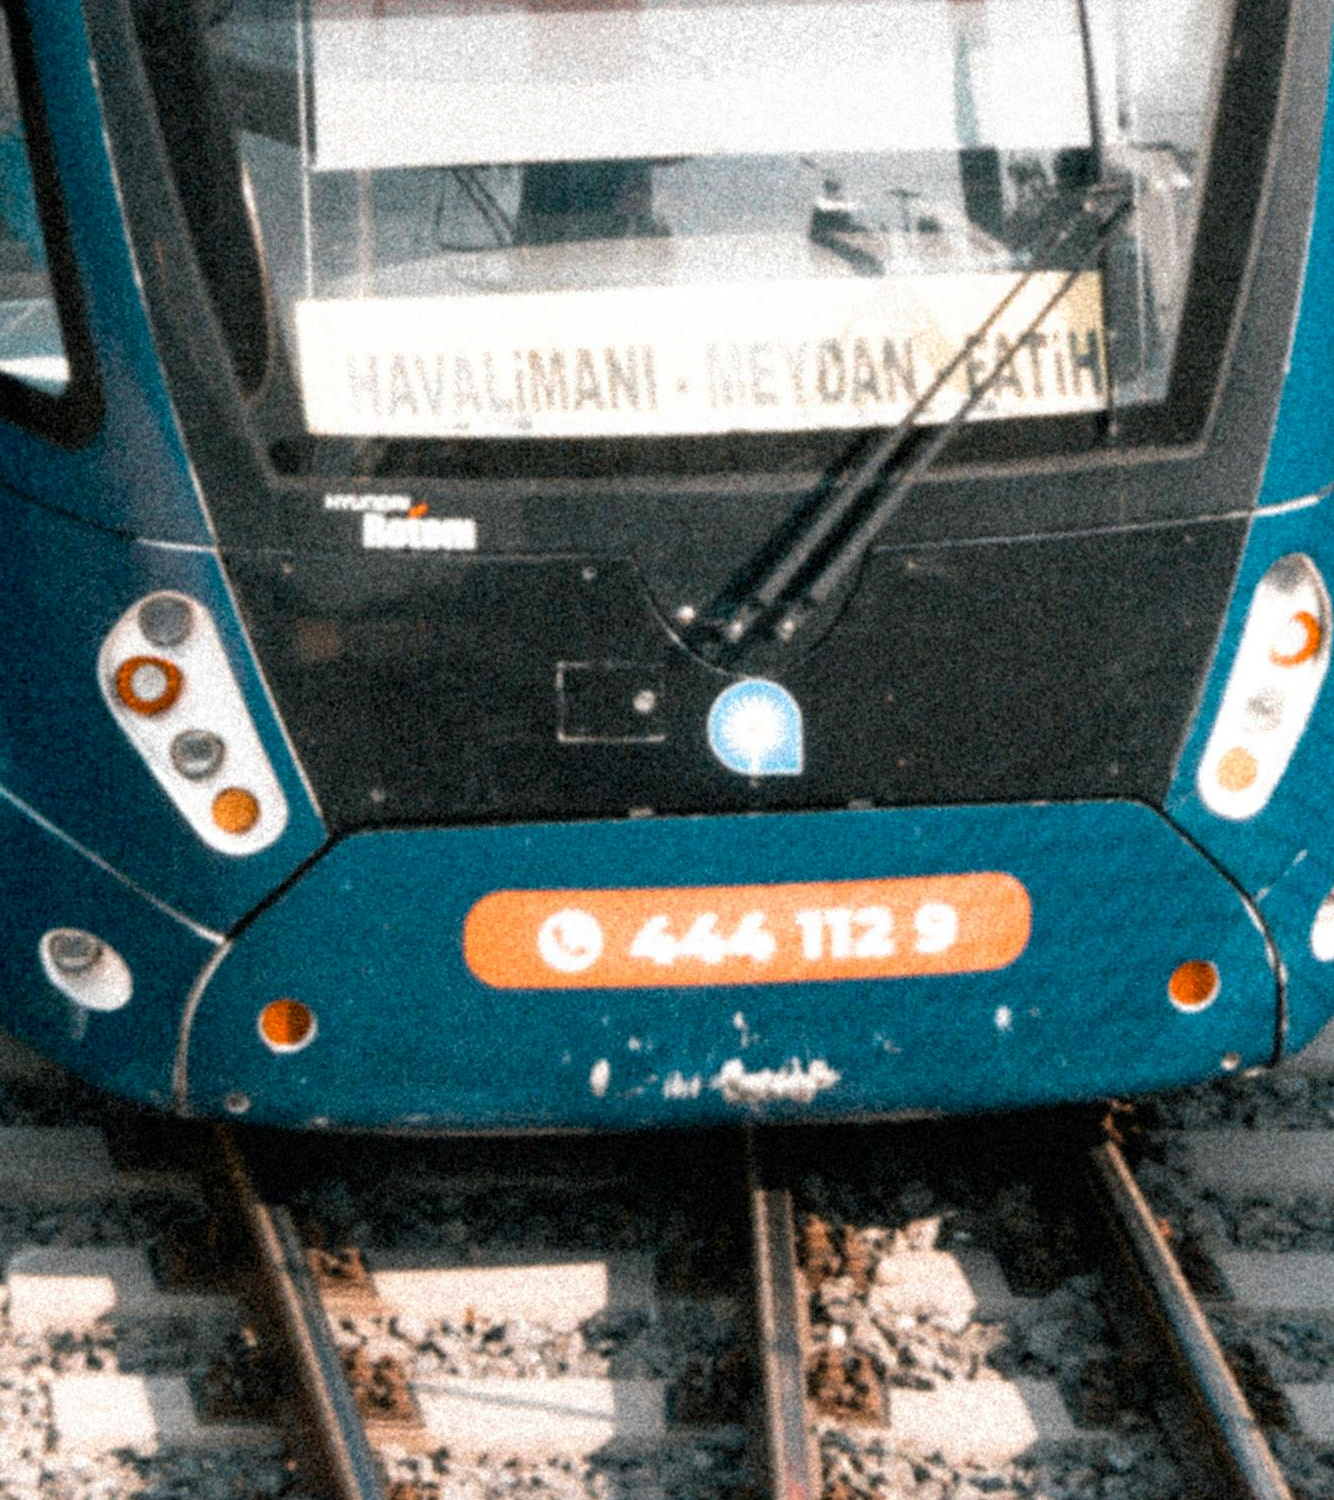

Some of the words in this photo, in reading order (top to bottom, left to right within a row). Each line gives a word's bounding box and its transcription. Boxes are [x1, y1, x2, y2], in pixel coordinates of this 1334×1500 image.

[629, 910, 777, 965] 444
[795, 904, 896, 961] 112
[913, 901, 959, 955] 9
